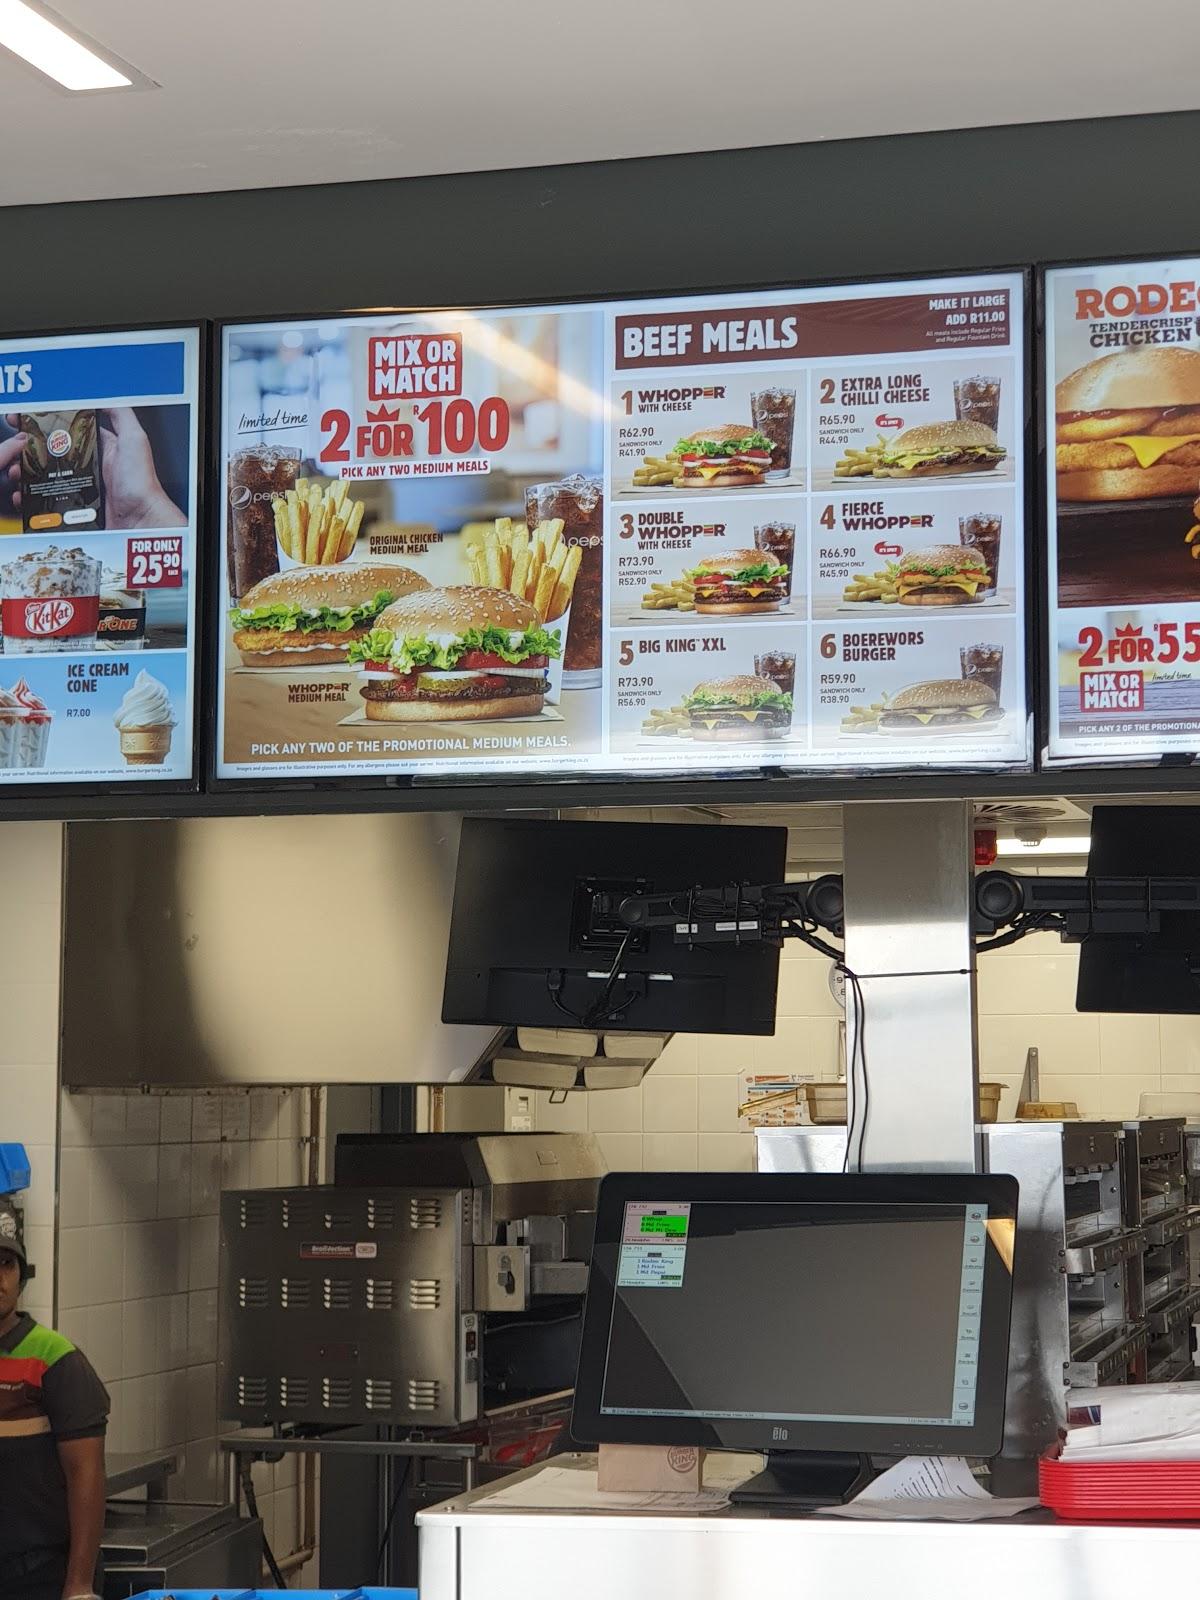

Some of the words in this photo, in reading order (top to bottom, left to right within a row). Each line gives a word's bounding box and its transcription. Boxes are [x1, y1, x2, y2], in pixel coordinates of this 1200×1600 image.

[929, 298, 958, 310] MAKE
[960, 297, 970, 308] IT
[972, 295, 1005, 308] LARGE
[1075, 281, 1200, 320] RODE
[945, 313, 967, 325] ADD
[969, 311, 1005, 323] R11.00
[1089, 317, 1193, 333] TENDERCRISP
[623, 324, 693, 358] BEEF
[702, 317, 798, 353] MEALS
[1089, 328, 1192, 348] CHICKEN
[375, 340, 423, 368] MIX
[426, 339, 456, 362] OR
[374, 366, 456, 395] MATCH
[820, 378, 835, 404] 2
[841, 376, 882, 392] EXTRA
[887, 374, 922, 389] LONG
[620, 390, 633, 416] 1
[637, 386, 725, 404] WHOPPER
[841, 391, 879, 407] CHILLI
[883, 388, 930, 404] CHEESE
[638, 403, 659, 414] WITH
[662, 401, 692, 412] CHEESE
[238, 409, 279, 430] limited
[282, 411, 308, 425] time
[819, 414, 855, 426] R65.90
[320, 408, 350, 462] 2
[357, 424, 413, 458] FOR
[619, 427, 654, 438] R62.90
[819, 435, 848, 445] R44.90
[619, 448, 646, 457] R41.90
[341, 466, 363, 478] PICK
[366, 466, 385, 477] ANY
[388, 464, 410, 476] TWO
[413, 463, 453, 475] MEDIUM
[456, 460, 488, 472] MEALS
[820, 504, 836, 530] 4
[842, 501, 884, 516] FIERCE
[619, 513, 634, 540] 3
[638, 512, 684, 526] DOUBLE
[842, 514, 933, 532] WHOPPER
[638, 524, 725, 540] WHOPPER
[132, 541, 152, 553] FOR
[153, 540, 180, 552] ONLY
[370, 534, 408, 546] ORIGINAL
[409, 533, 443, 544] CHICKEN
[638, 541, 659, 550] WITH
[661, 539, 692, 549] CHEESE
[370, 545, 404, 555] MEDIUM
[407, 544, 429, 554] MEAL
[820, 548, 856, 559] R66.90
[619, 556, 654, 567] R73.90
[819, 569, 849, 578] R45.90
[618, 577, 647, 586] R52.90
[619, 640, 633, 666] 5
[639, 640, 661, 654] BIG
[702, 638, 727, 651] XXL
[820, 633, 837, 659] 6
[843, 631, 924, 648] BOEREWORS
[1078, 626, 1103, 667] 2
[1108, 638, 1155, 663] FOR
[843, 648, 895, 662] BURGER
[68, 664, 85, 677] ICE
[89, 663, 129, 677] CREAM
[1152, 671, 1176, 681] limited
[618, 677, 654, 687] R73.90
[821, 673, 856, 684] R59.90
[1084, 674, 1117, 691] MIX
[1119, 674, 1140, 689] OR
[67, 679, 97, 693] CONE
[288, 683, 350, 693] WHOPPER
[288, 693, 322, 703] MEDIUM
[325, 693, 346, 702] MEAL
[617, 698, 646, 707] R56.90
[820, 695, 849, 704] R38.90
[1084, 690, 1140, 709] MATCH
[66, 709, 91, 718] R7.00
[1079, 725, 1098, 733] PICK
[1098, 725, 1114, 733] ANY
[1122, 724, 1133, 732] OF
[1134, 723, 1151, 731] THE
[251, 743, 279, 755] PICK
[281, 743, 306, 754] ANY
[309, 742, 335, 753] TWO
[338, 741, 354, 753] OF
[356, 741, 380, 753] THE
[383, 738, 469, 752] PROMOTIONAL
[472, 737, 522, 750] MEDIUM
[526, 735, 571, 748] MEALS.
[836, 976, 843, 984] 9
